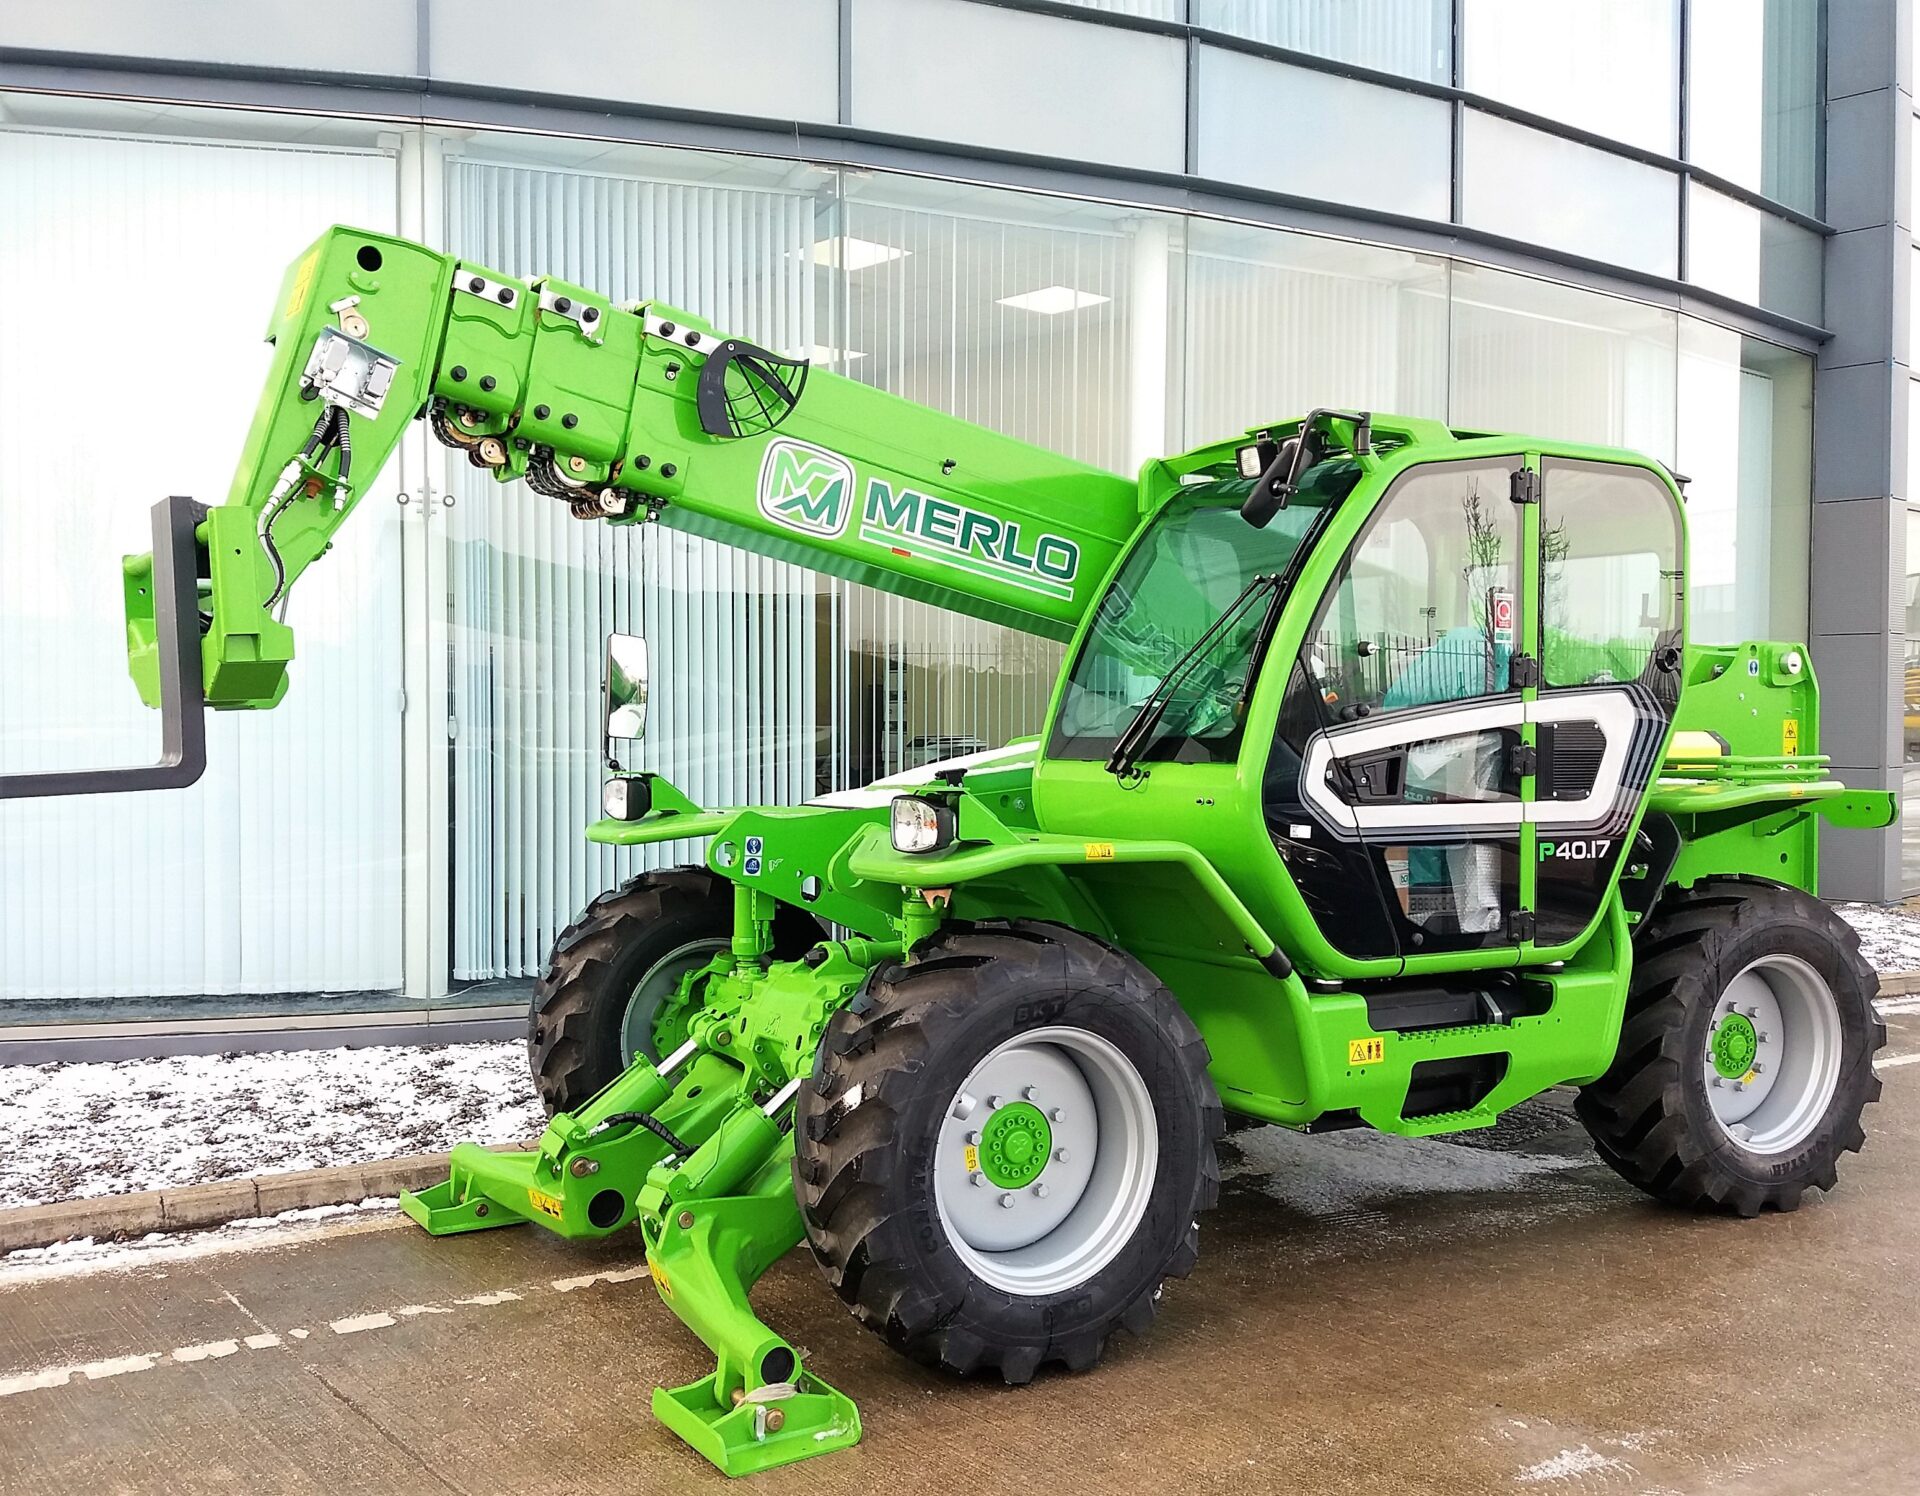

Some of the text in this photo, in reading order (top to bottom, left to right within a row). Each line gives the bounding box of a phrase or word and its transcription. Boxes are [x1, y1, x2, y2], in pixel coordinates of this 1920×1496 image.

[863, 479, 1079, 582] MERLO
[1538, 839, 1611, 862] P40.17
[1016, 999, 1065, 1022] BKT
